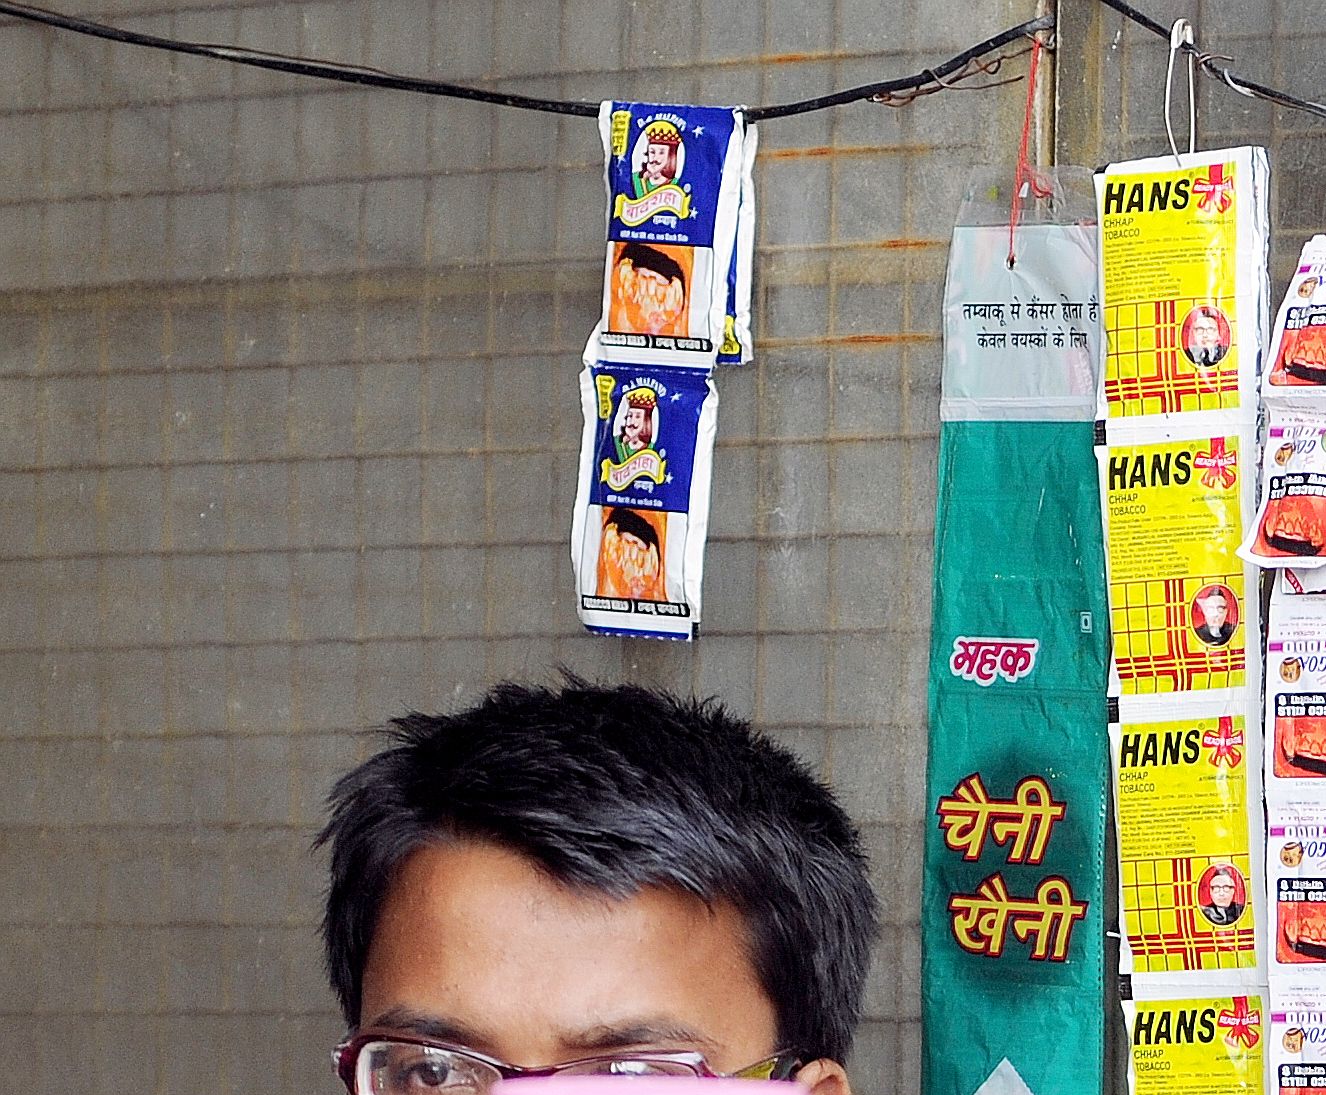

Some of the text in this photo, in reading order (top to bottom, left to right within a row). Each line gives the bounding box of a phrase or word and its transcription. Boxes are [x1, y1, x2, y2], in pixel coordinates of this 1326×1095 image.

[1104, 179, 1190, 215] HANS
[1104, 217, 1134, 228] CHHAP
[1105, 228, 1140, 240] TOBACCO
[1010, 296, 1021, 320] से
[1060, 293, 1083, 321] होता
[976, 326, 1006, 348] केवल
[1052, 326, 1065, 348] के
[1070, 326, 1088, 348] लिए
[1108, 451, 1191, 490] HANS
[1109, 494, 1138, 504] CHHAP
[1110, 505, 1146, 515] TOBACCO
[952, 638, 1038, 684] महक
[1120, 729, 1200, 768] HANS
[1120, 771, 1148, 782] CHHAP
[1120, 783, 1155, 794] TOBACCO
[937, 772, 1066, 865] चैनी
[949, 872, 1088, 964] खैनी
[1134, 1009, 1216, 1045] HANS
[1134, 1049, 1164, 1059] CHHAP
[1136, 1061, 1171, 1071] TOBACCO
